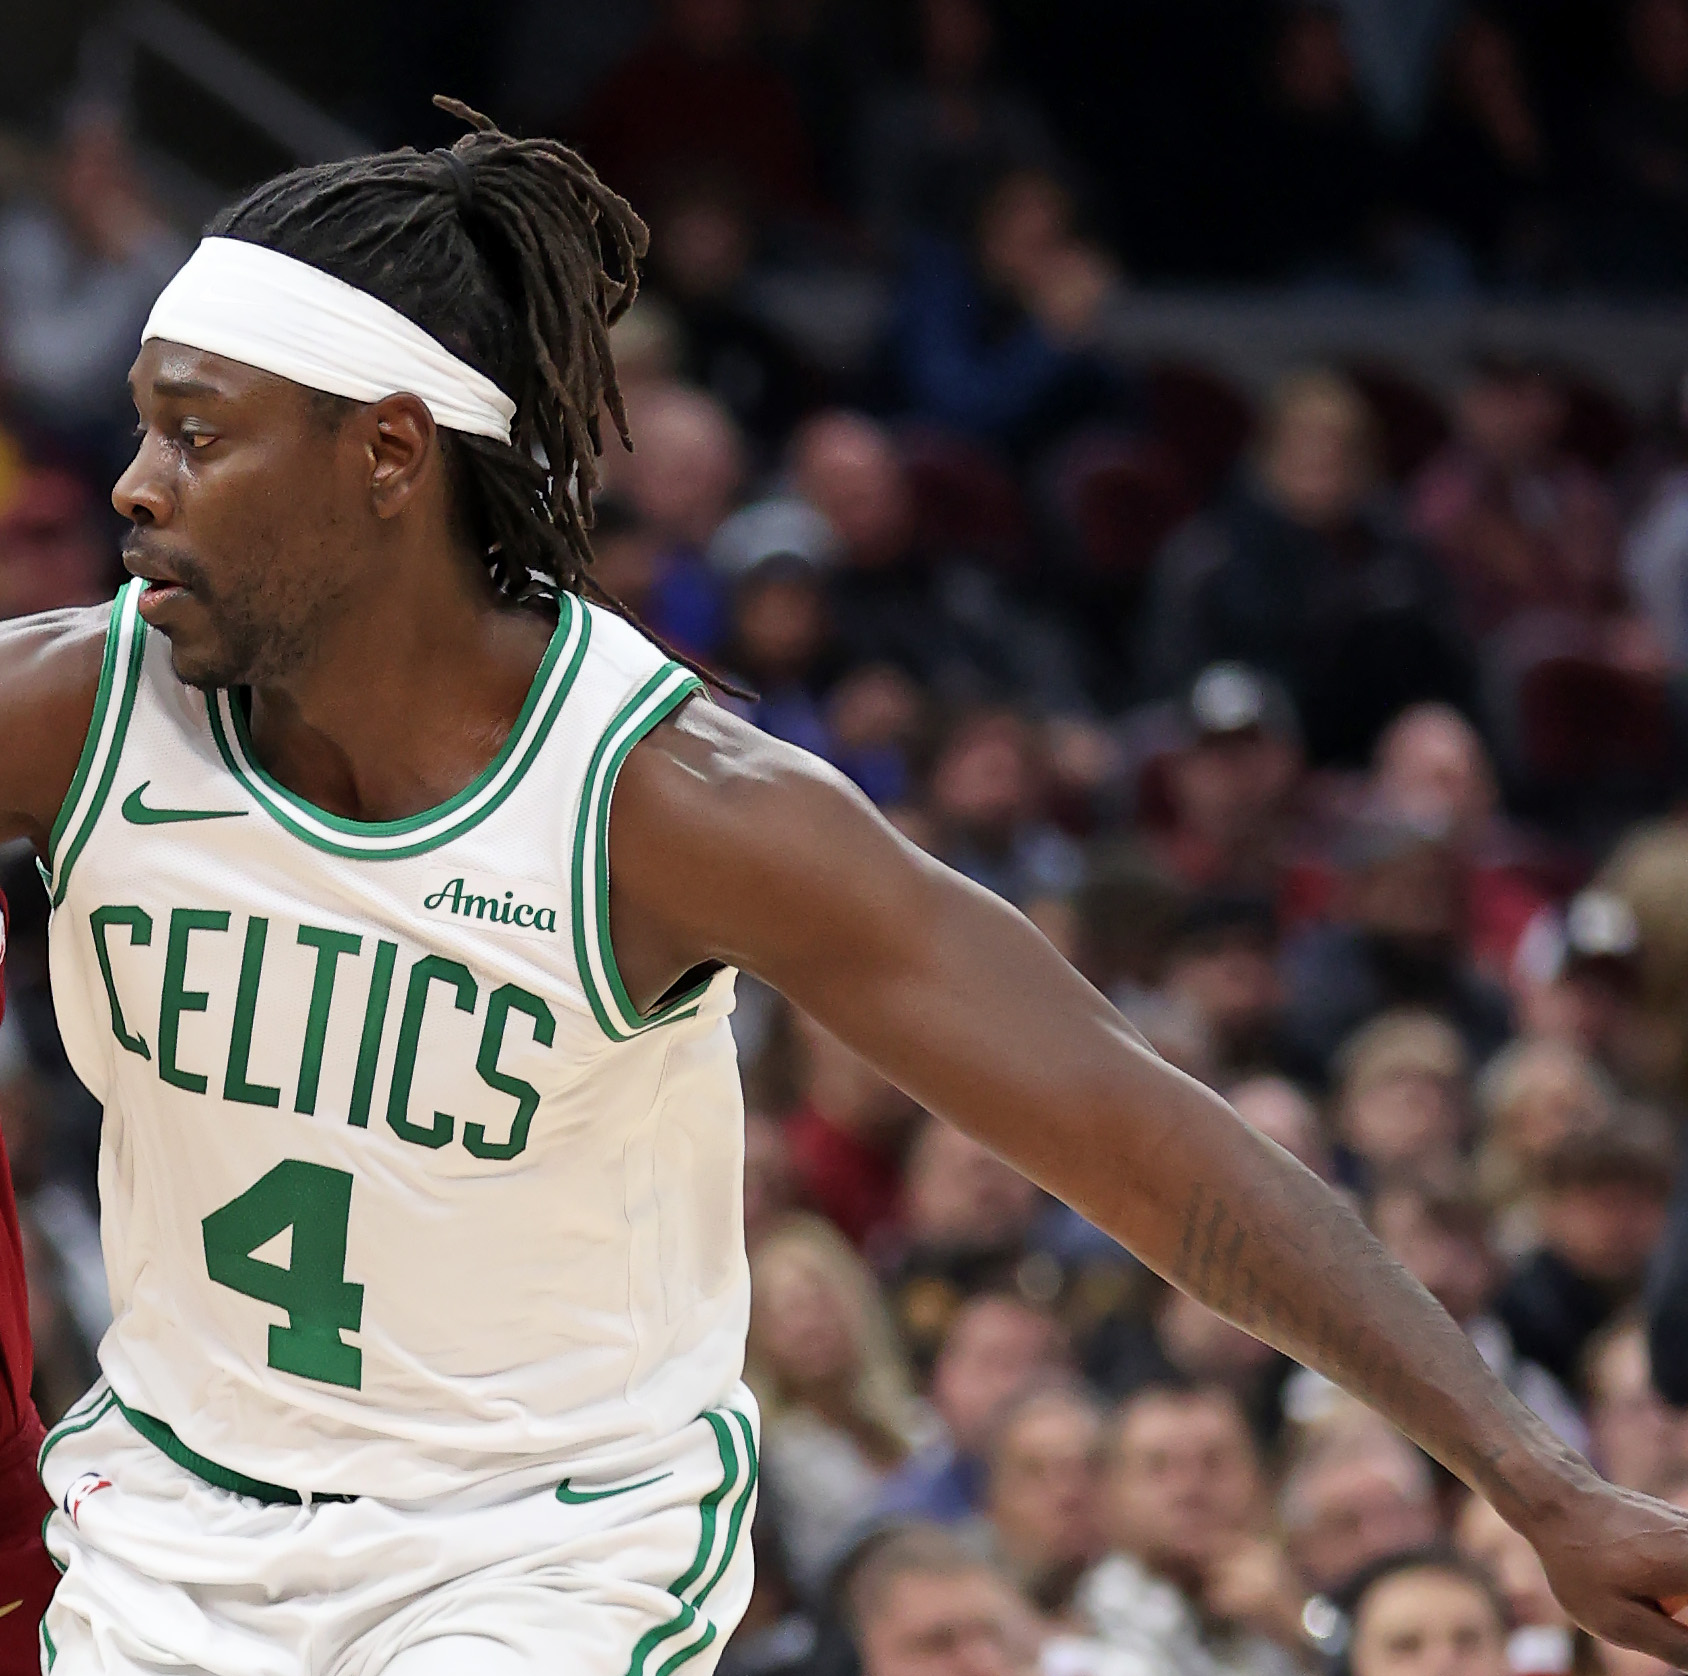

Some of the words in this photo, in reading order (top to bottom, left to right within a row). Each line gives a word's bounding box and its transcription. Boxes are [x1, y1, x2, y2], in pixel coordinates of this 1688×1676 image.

[423, 878, 557, 933] Amica
[90, 905, 556, 1161] CELTICS
[201, 1159, 365, 1391] 4
